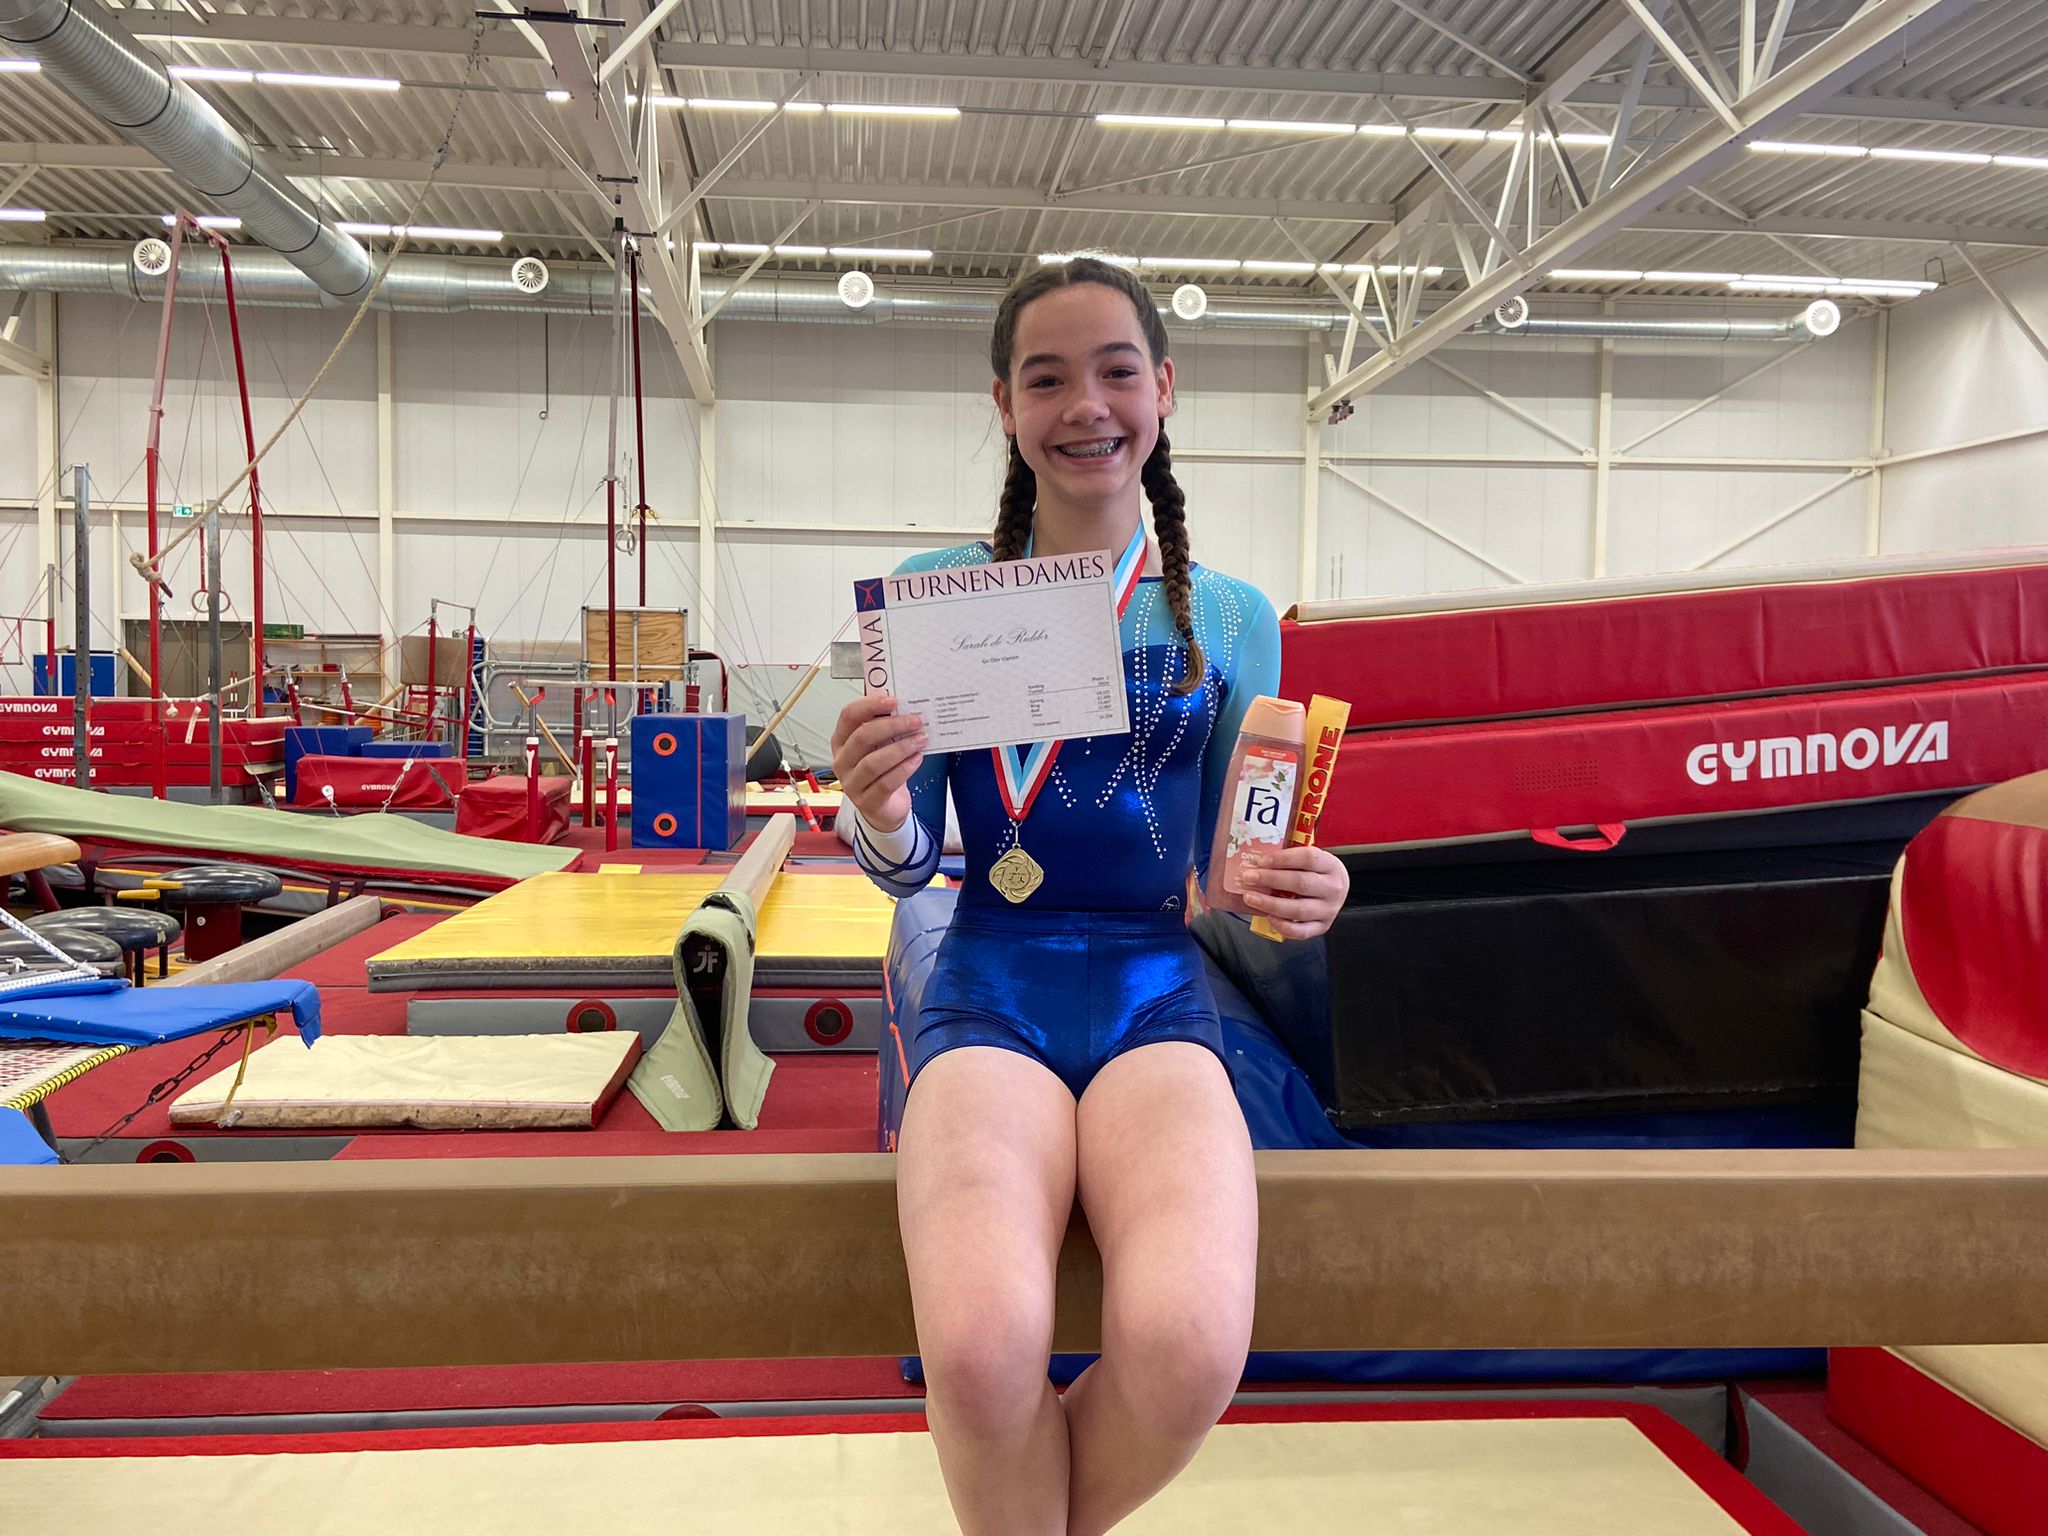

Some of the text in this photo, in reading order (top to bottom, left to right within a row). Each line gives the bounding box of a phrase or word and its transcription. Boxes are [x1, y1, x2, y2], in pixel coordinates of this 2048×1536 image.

[889, 555, 1105, 600] TURNEN DAMES
[43, 726, 104, 736] GYMVA
[1686, 721, 1949, 786] GYMNOVA
[1244, 787, 1280, 826] Fa
[1291, 726, 1341, 848] LERONE
